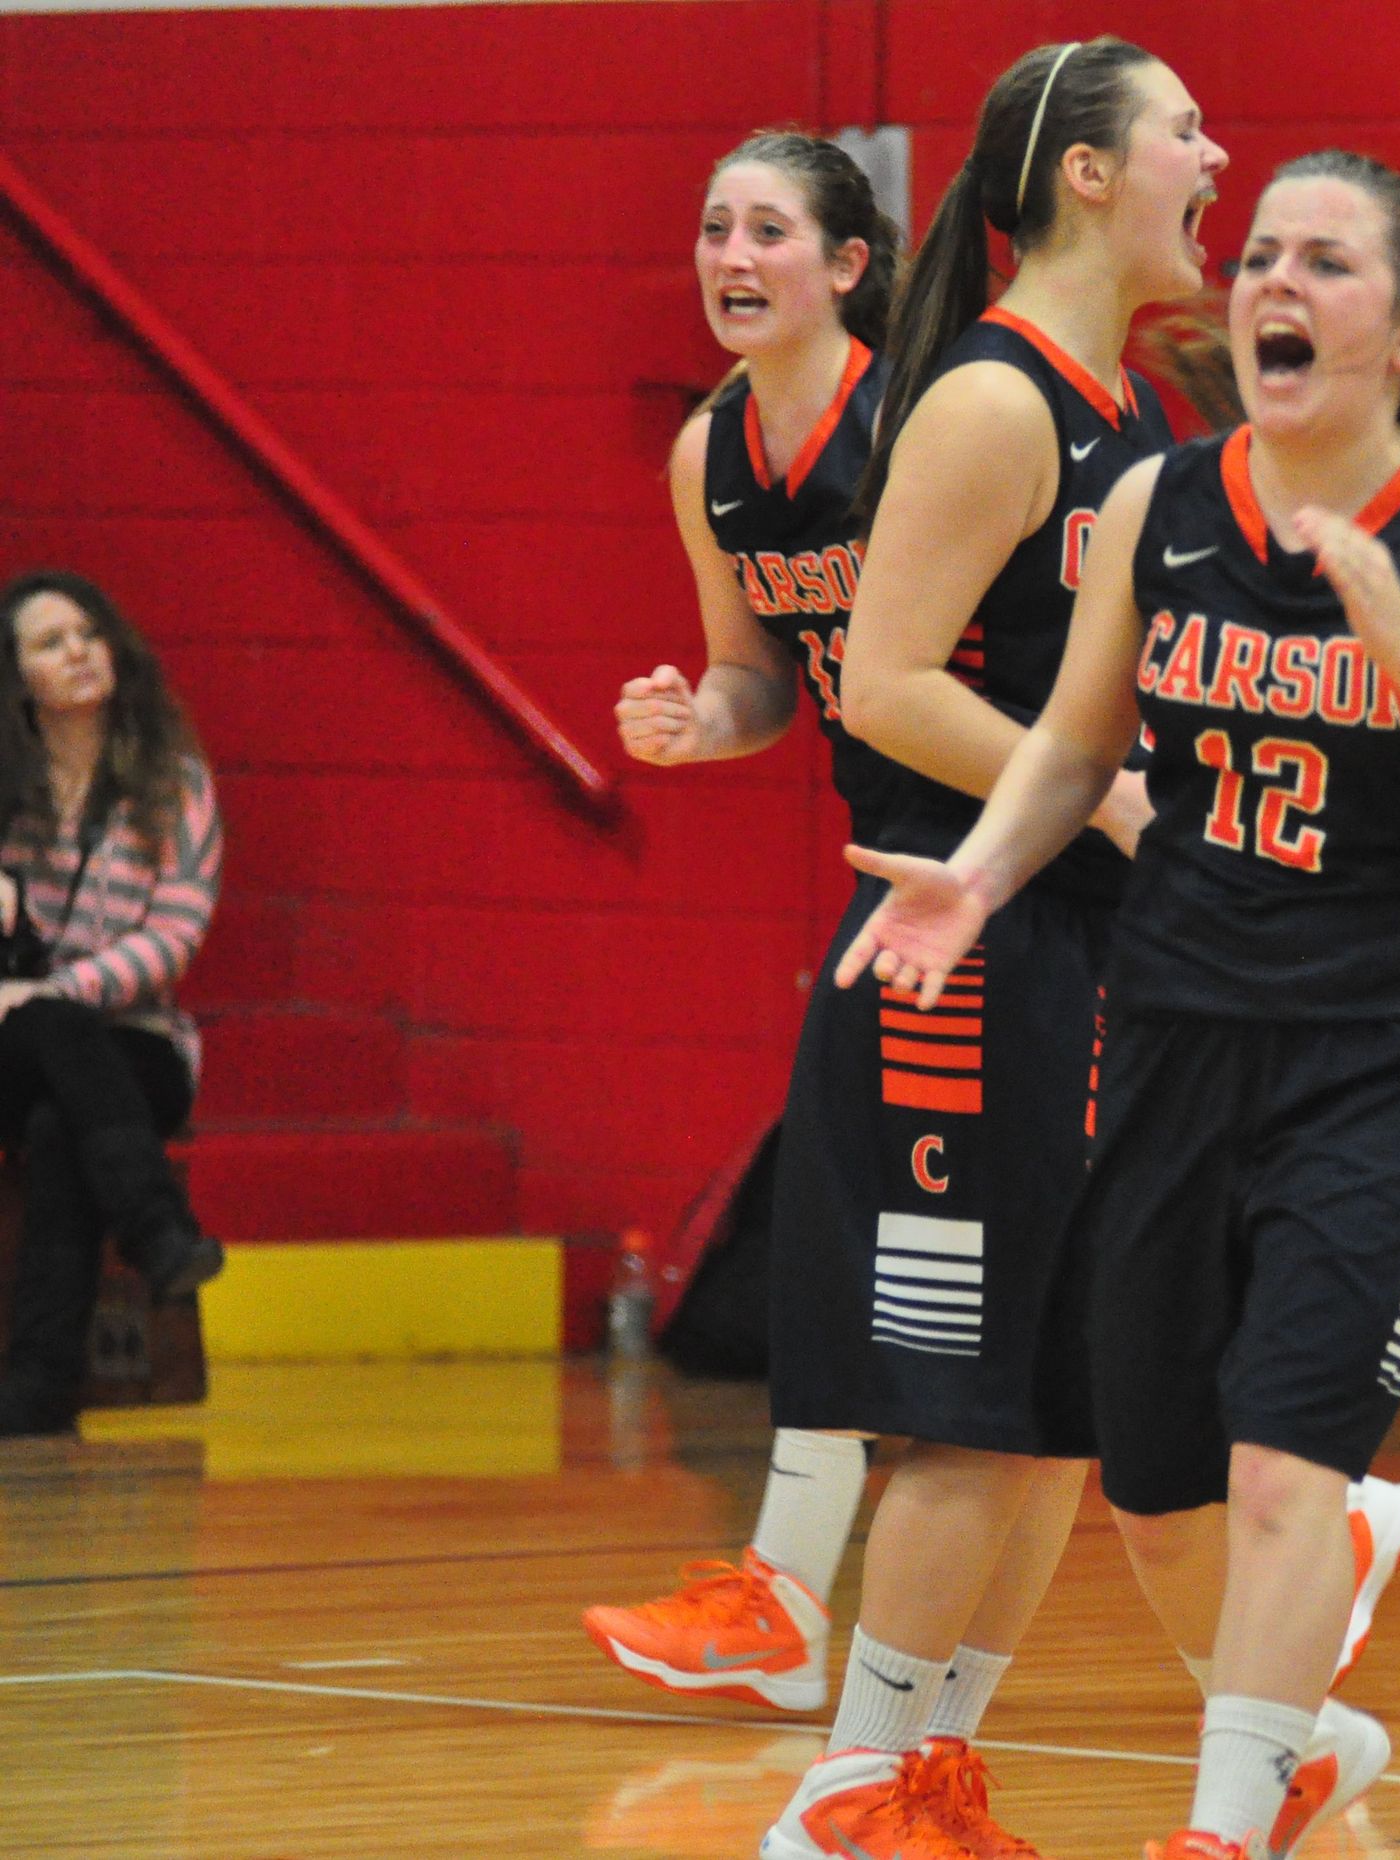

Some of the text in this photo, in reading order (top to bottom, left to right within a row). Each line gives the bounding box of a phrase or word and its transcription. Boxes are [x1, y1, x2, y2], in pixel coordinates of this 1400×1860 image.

[737, 539, 868, 616] ARSO
[1194, 728, 1329, 874] 12
[911, 1133, 949, 1193] C
